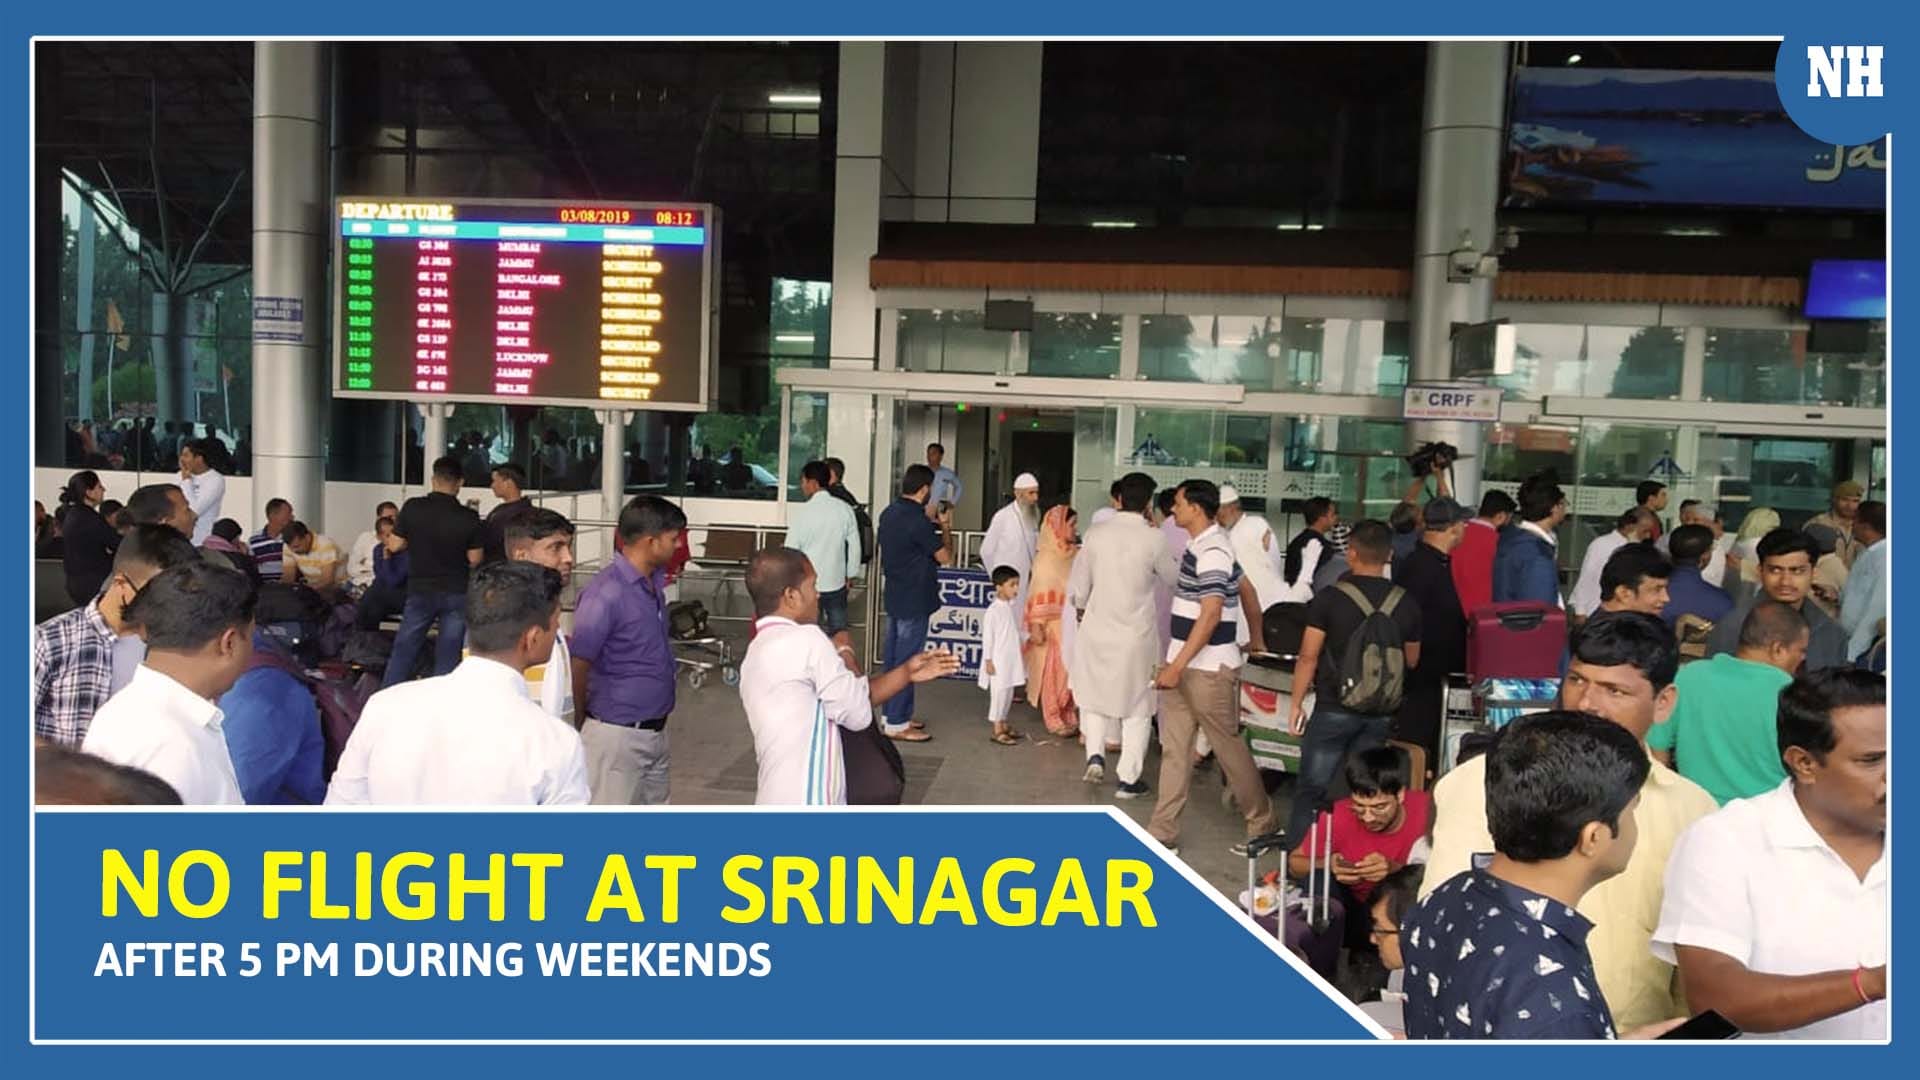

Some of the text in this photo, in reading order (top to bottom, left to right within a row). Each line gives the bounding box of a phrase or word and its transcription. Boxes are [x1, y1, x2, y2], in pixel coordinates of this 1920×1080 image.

[342, 203, 693, 225] DEPARTURE 03/08/2019 08:12
[498, 274, 560, 284] BANGALORE
[497, 353, 548, 363] LUCKNOW
[1428, 393, 1475, 407] CRPF
